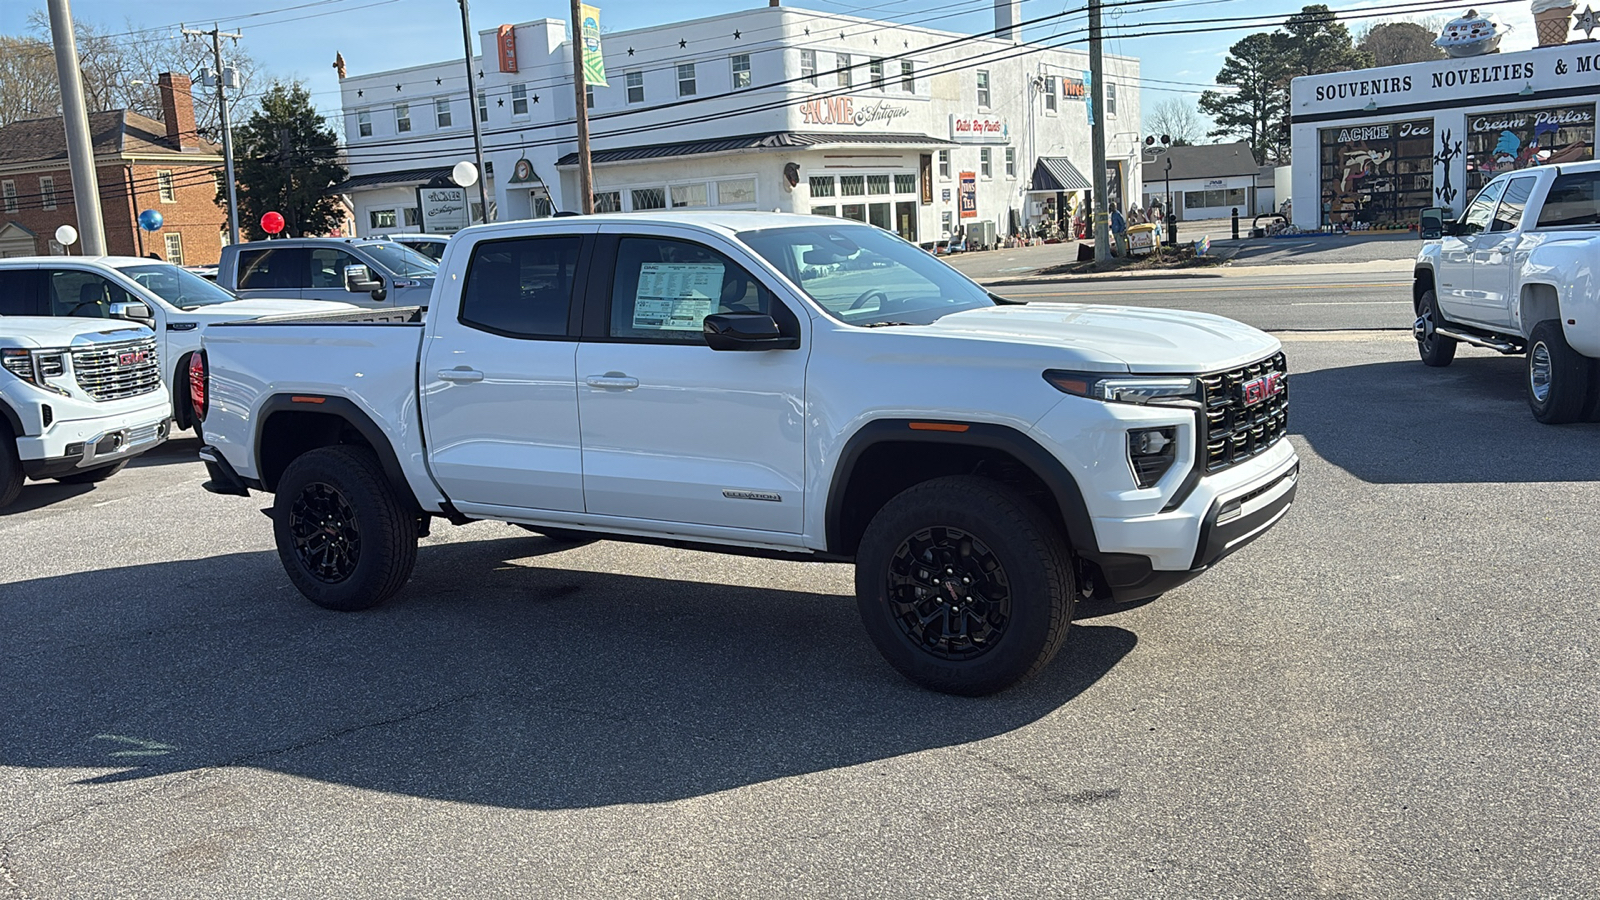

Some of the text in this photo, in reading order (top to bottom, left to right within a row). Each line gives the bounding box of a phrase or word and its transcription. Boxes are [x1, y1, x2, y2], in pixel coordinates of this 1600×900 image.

[506, 27, 515, 70] ACME
[1316, 76, 1412, 101] SOUVENIRS
[1432, 62, 1534, 88] NOVELTIES
[1555, 58, 1568, 75] &
[800, 95, 909, 126] ACME Antiques
[956, 119, 1001, 135] Dutch Boy Paints
[1473, 111, 1592, 132] Cream Parlor
[1338, 122, 1431, 143] ACME Ice
[963, 198, 974, 209] TEA
[119, 351, 149, 367] GMC
[1244, 373, 1281, 404] GMC
[726, 491, 777, 500] ELEVATION
